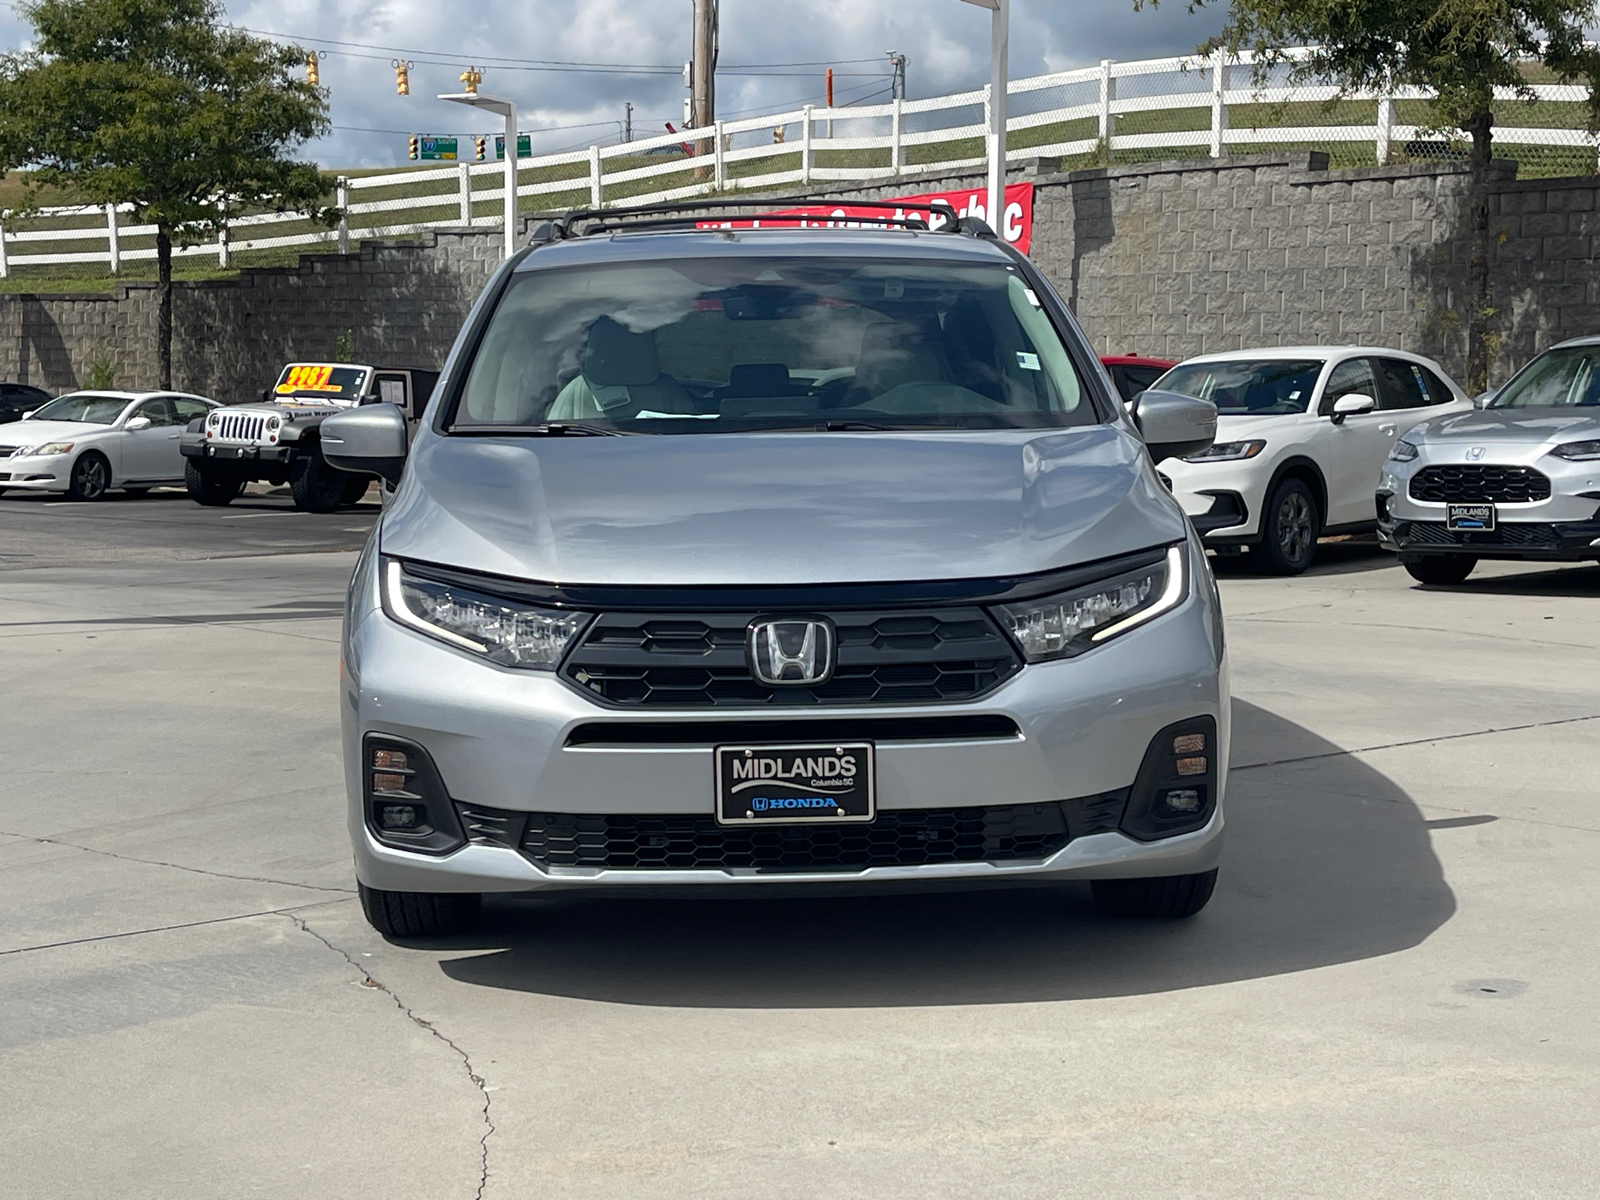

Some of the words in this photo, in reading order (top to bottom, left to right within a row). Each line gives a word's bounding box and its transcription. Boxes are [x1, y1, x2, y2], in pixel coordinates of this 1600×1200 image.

[287, 366, 333, 385] 9987
[732, 756, 857, 779] MIDLANDS
[811, 778, 842, 787] Columbia
[843, 778, 854, 786] SC
[769, 798, 839, 809] HONDA
